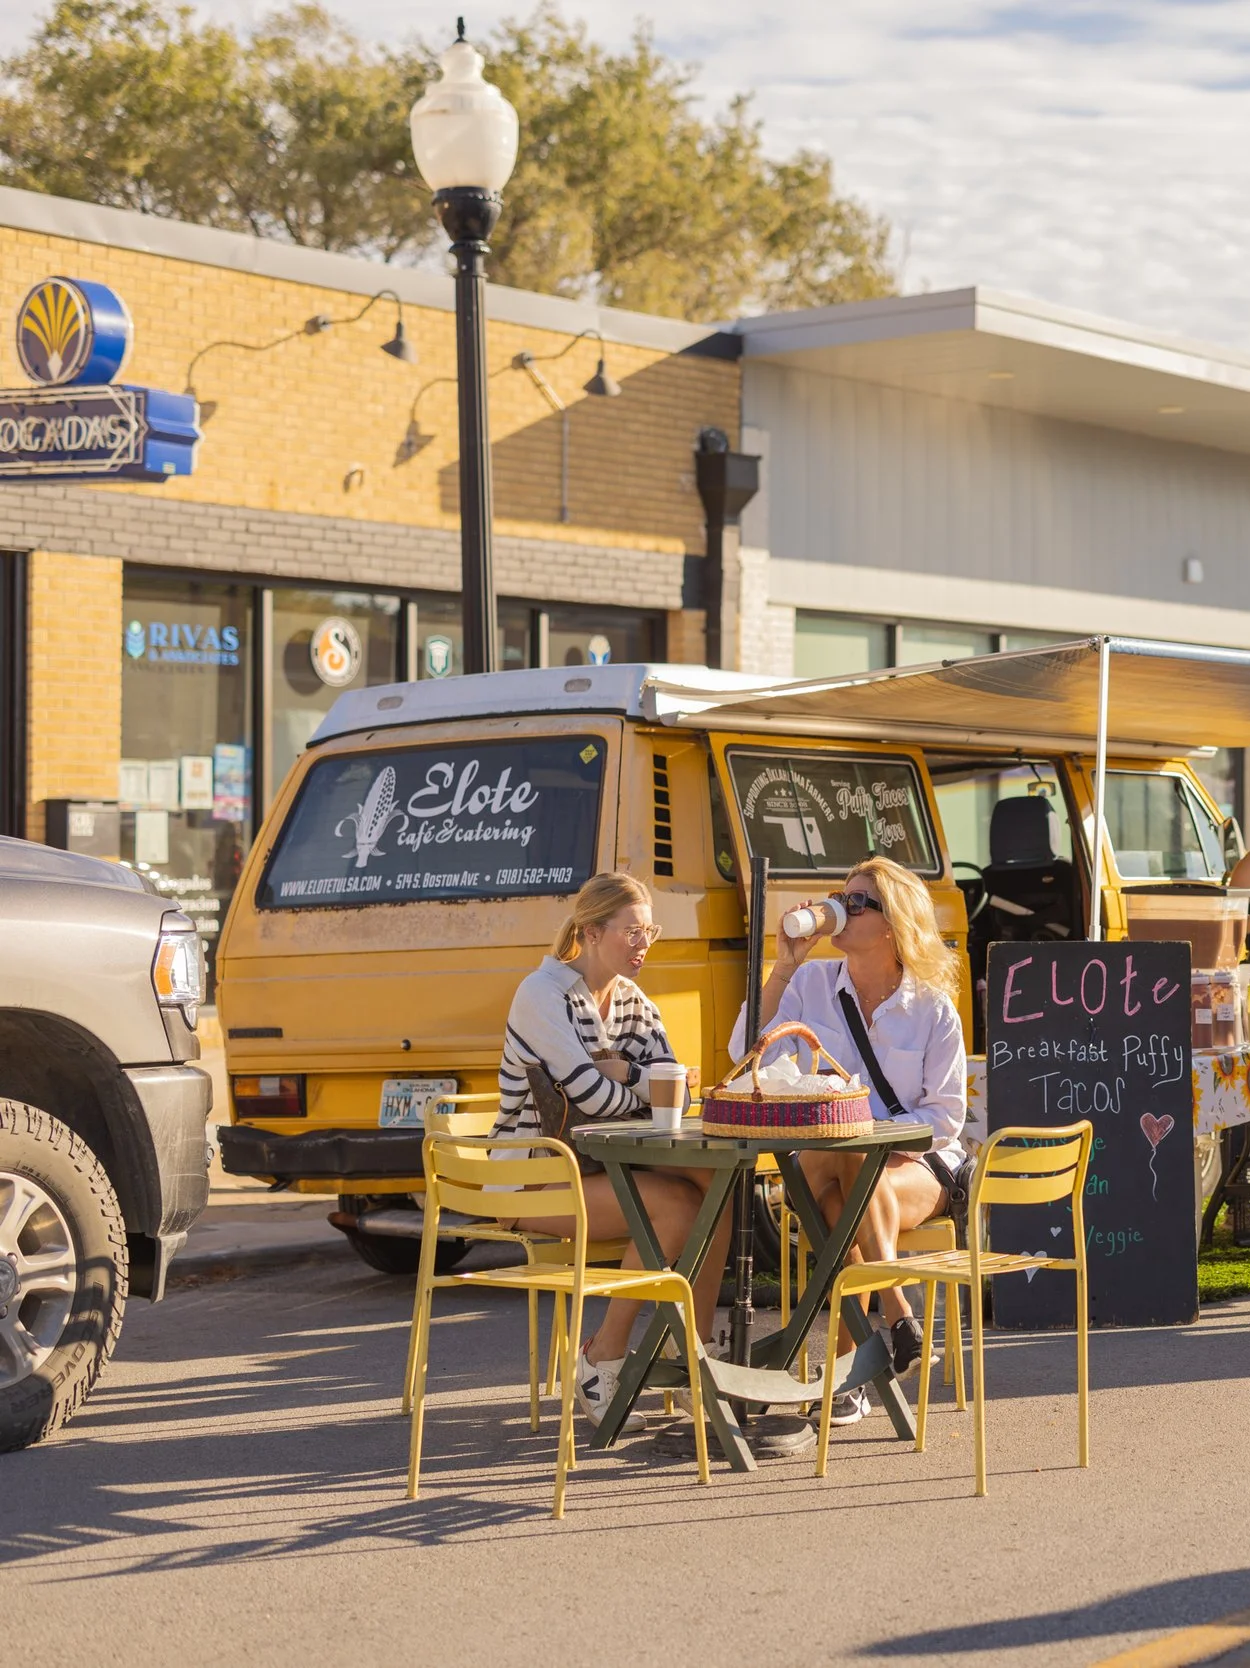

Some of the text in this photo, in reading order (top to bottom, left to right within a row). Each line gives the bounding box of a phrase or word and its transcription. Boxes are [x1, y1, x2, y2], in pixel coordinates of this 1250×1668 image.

[148, 622, 240, 651] RIVAS
[407, 760, 539, 818] Elote
[743, 771, 770, 819] SUPPORTING
[805, 778, 835, 822] FARMERS
[836, 782, 909, 822] Puffy Tacos
[454, 819, 537, 847] catering
[874, 817, 906, 848] Love
[280, 875, 382, 897] WWW.ELOTETULSA.COM
[395, 874, 412, 890] 514
[522, 867, 573, 884] 582-1403
[992, 1034, 1184, 1089] Breakfast Puffy
[384, 1095, 413, 1117] HXM
[1028, 1071, 1126, 1114] Tacos
